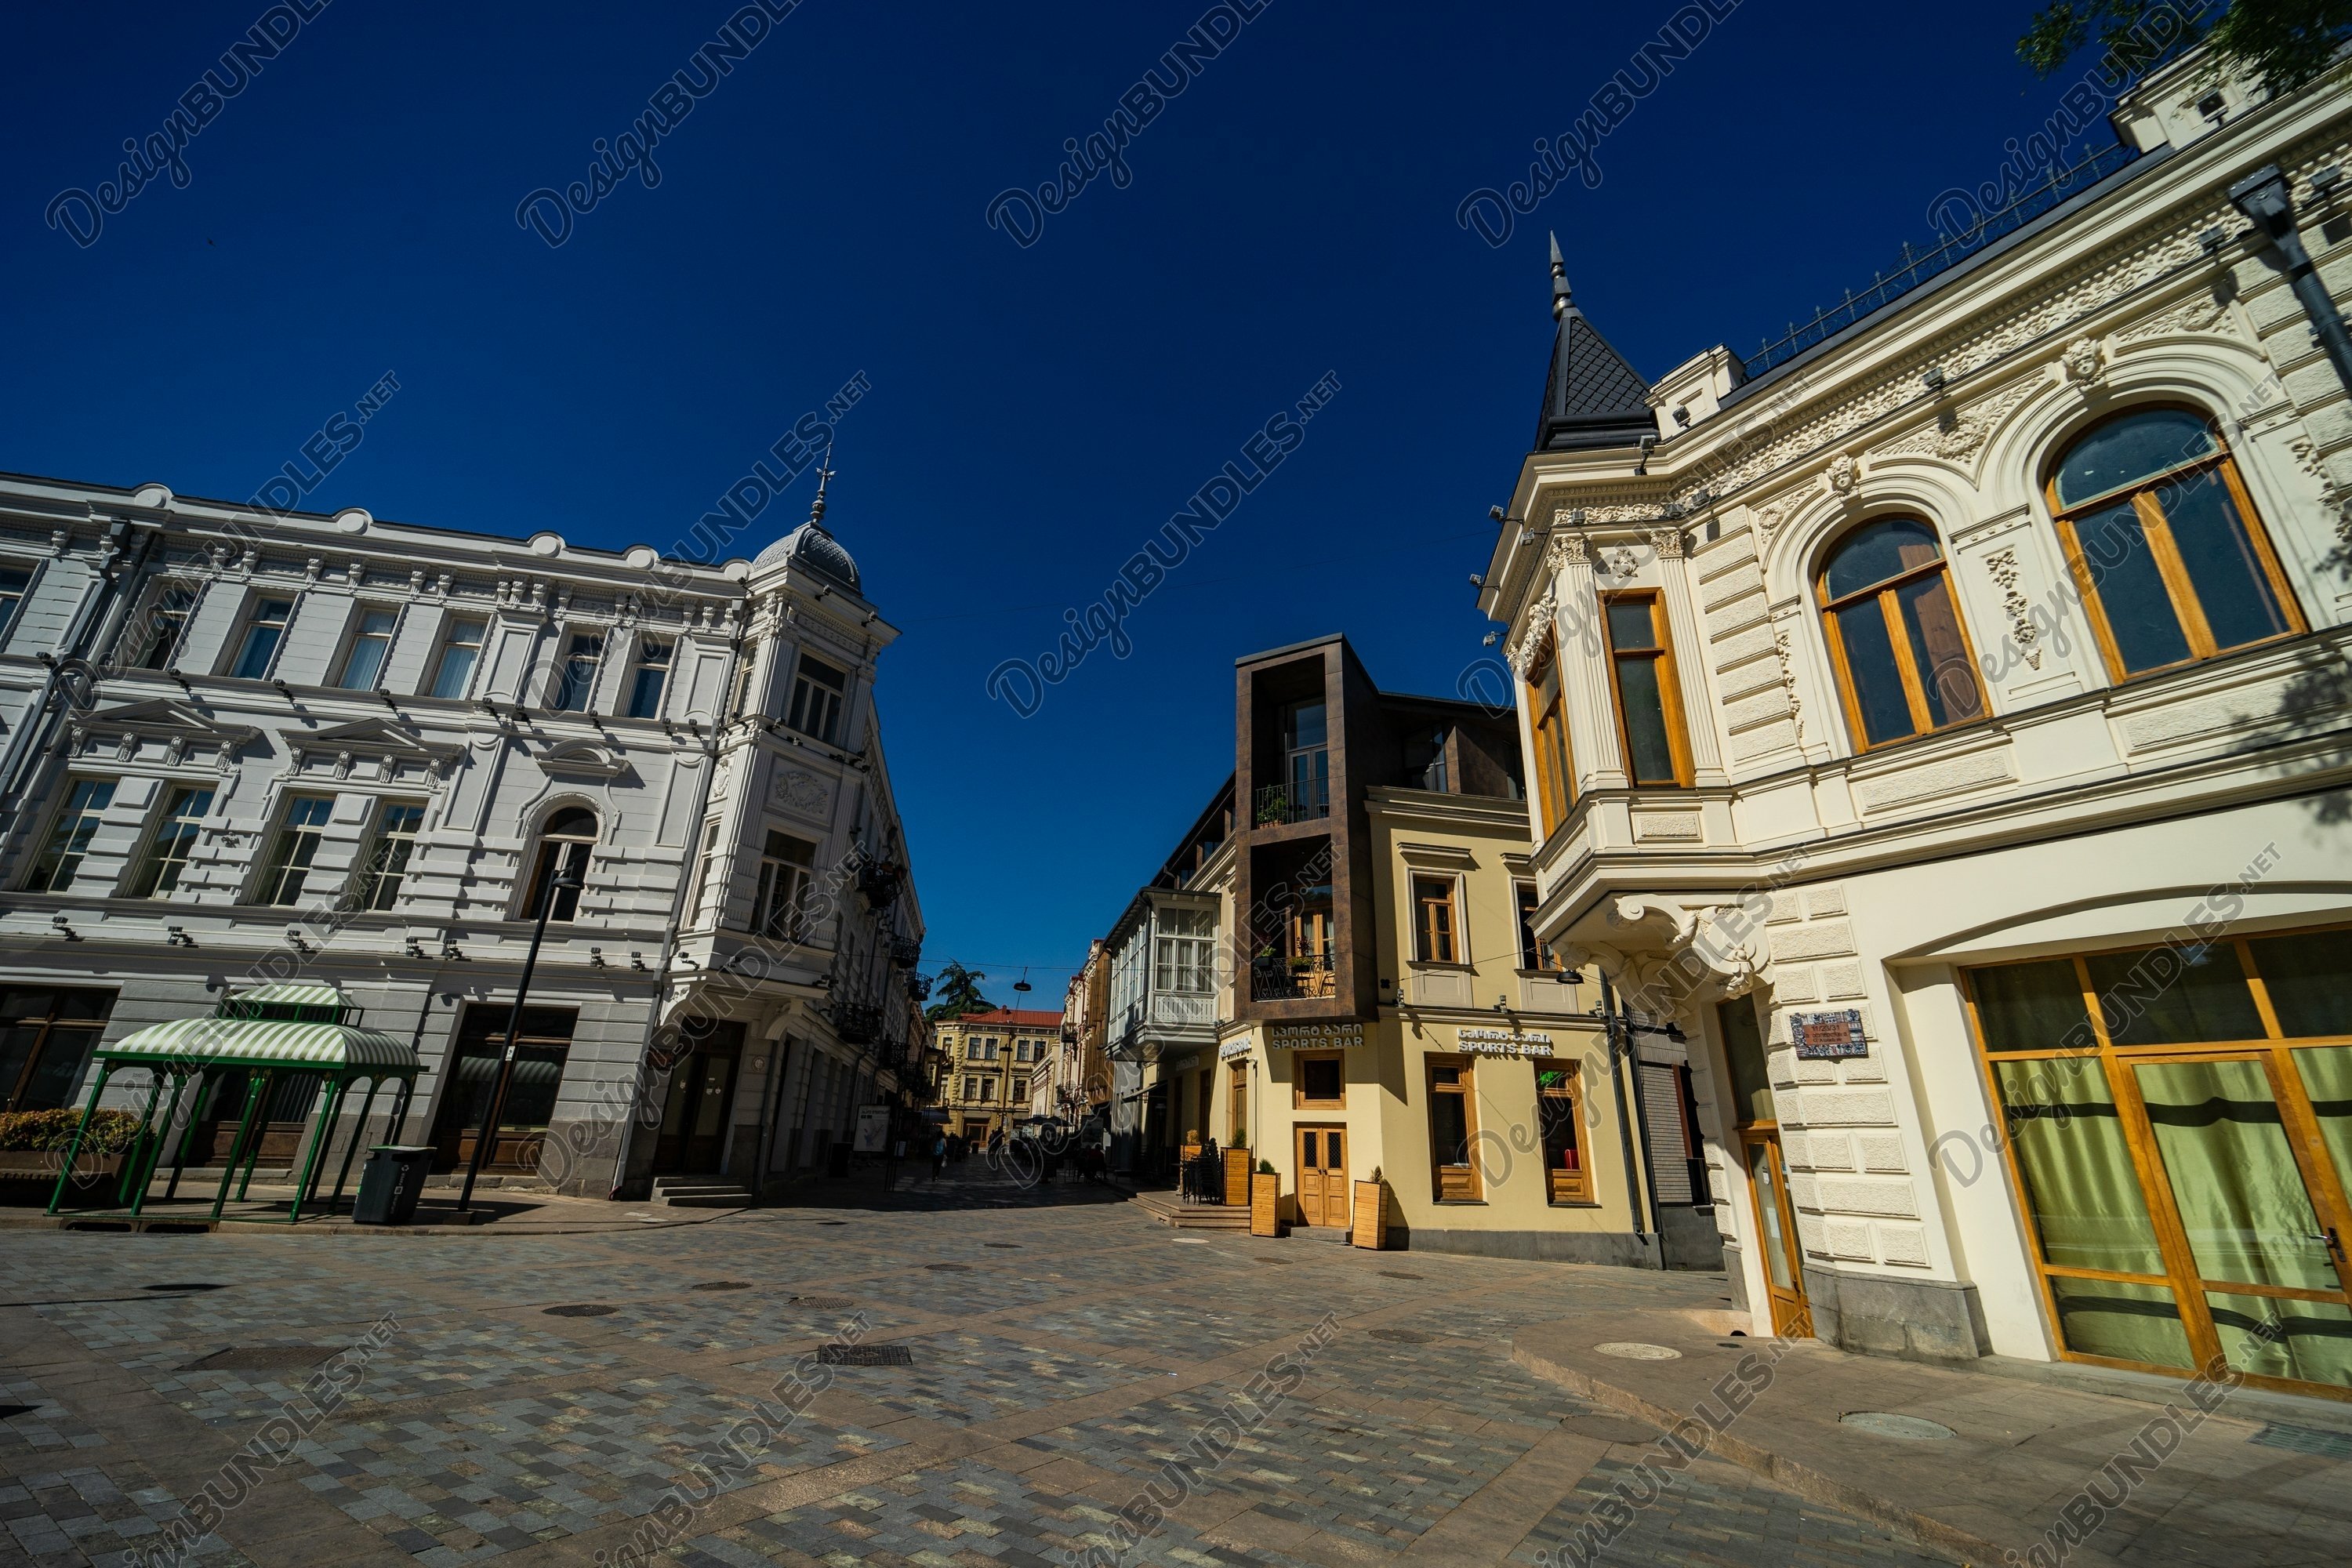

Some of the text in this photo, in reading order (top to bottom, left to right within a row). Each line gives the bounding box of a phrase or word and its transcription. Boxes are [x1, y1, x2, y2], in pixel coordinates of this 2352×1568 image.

[1271, 1024, 1363, 1037] სპორტ ბარი
[1272, 1036, 1363, 1050] SPORTS BAR
[1458, 1040, 1552, 1055] SPORTS BAR
